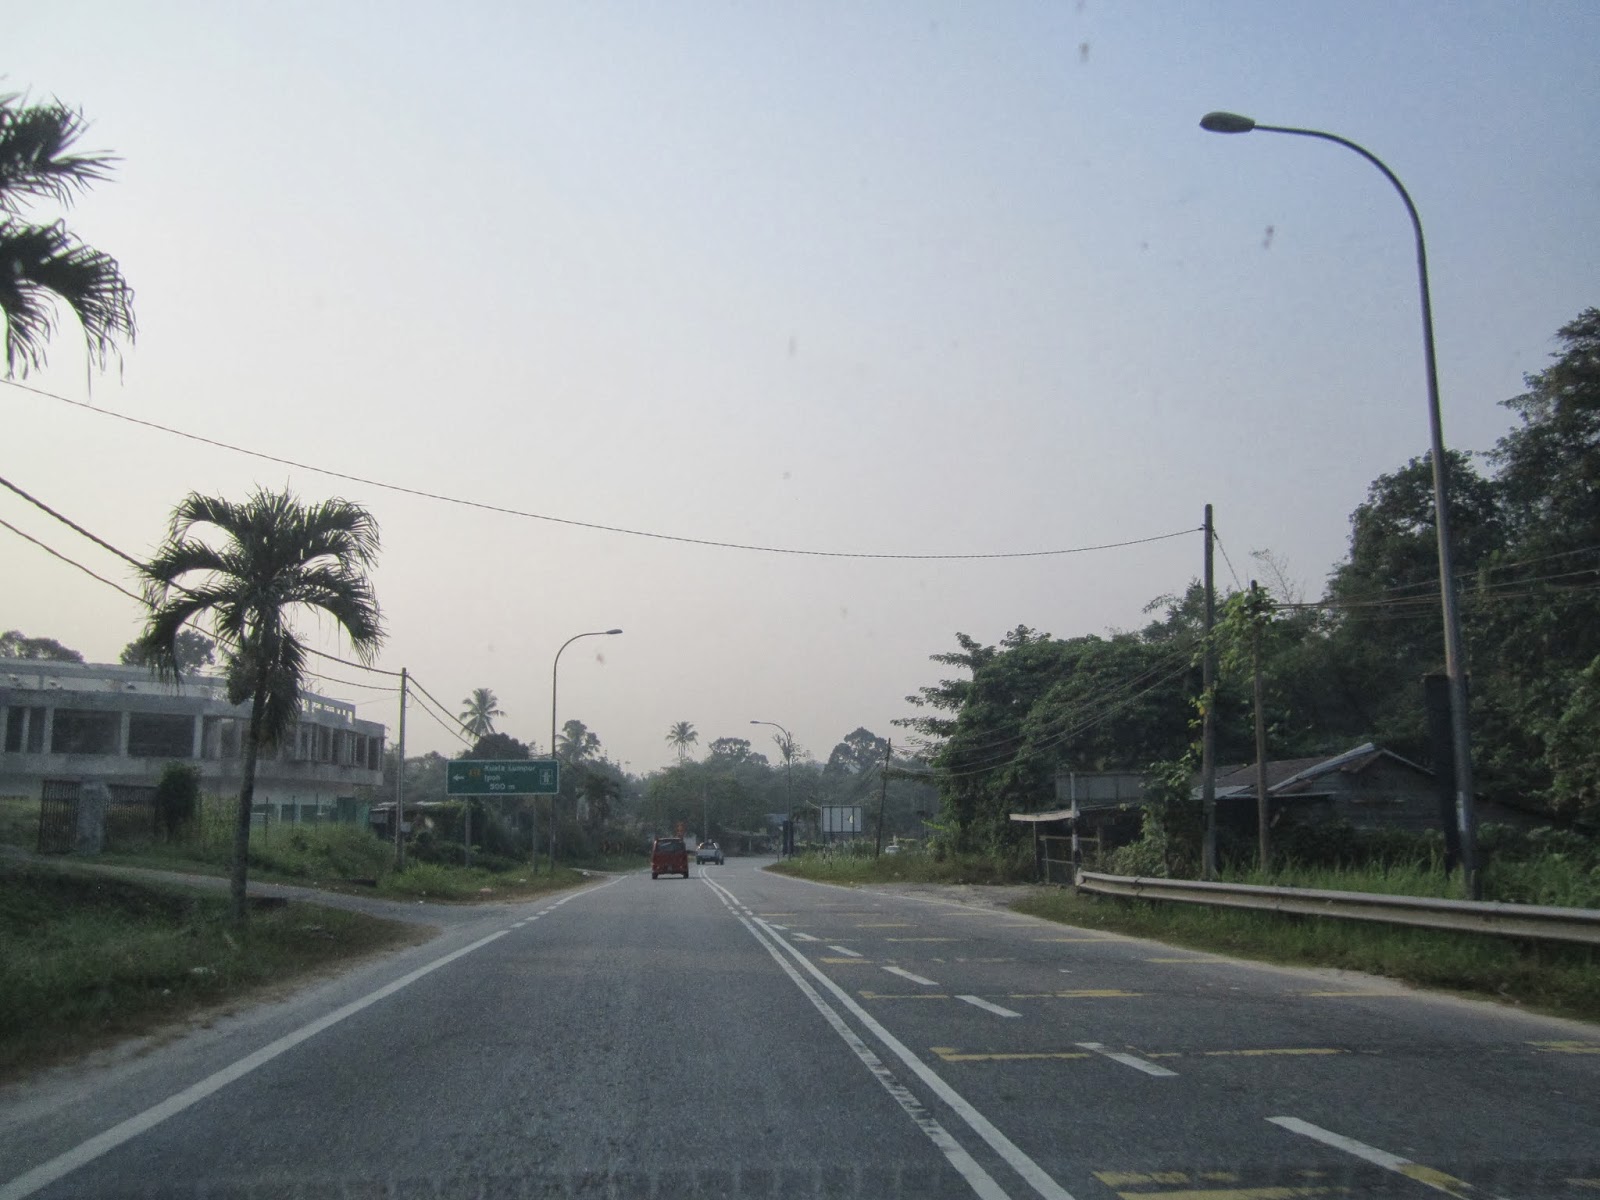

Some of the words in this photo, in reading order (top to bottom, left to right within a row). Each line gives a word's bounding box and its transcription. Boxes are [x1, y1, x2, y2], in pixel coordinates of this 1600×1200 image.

[484, 764, 505, 772] Kuala
[508, 764, 536, 773] Lumpur
[484, 774, 501, 782] Ipoh
